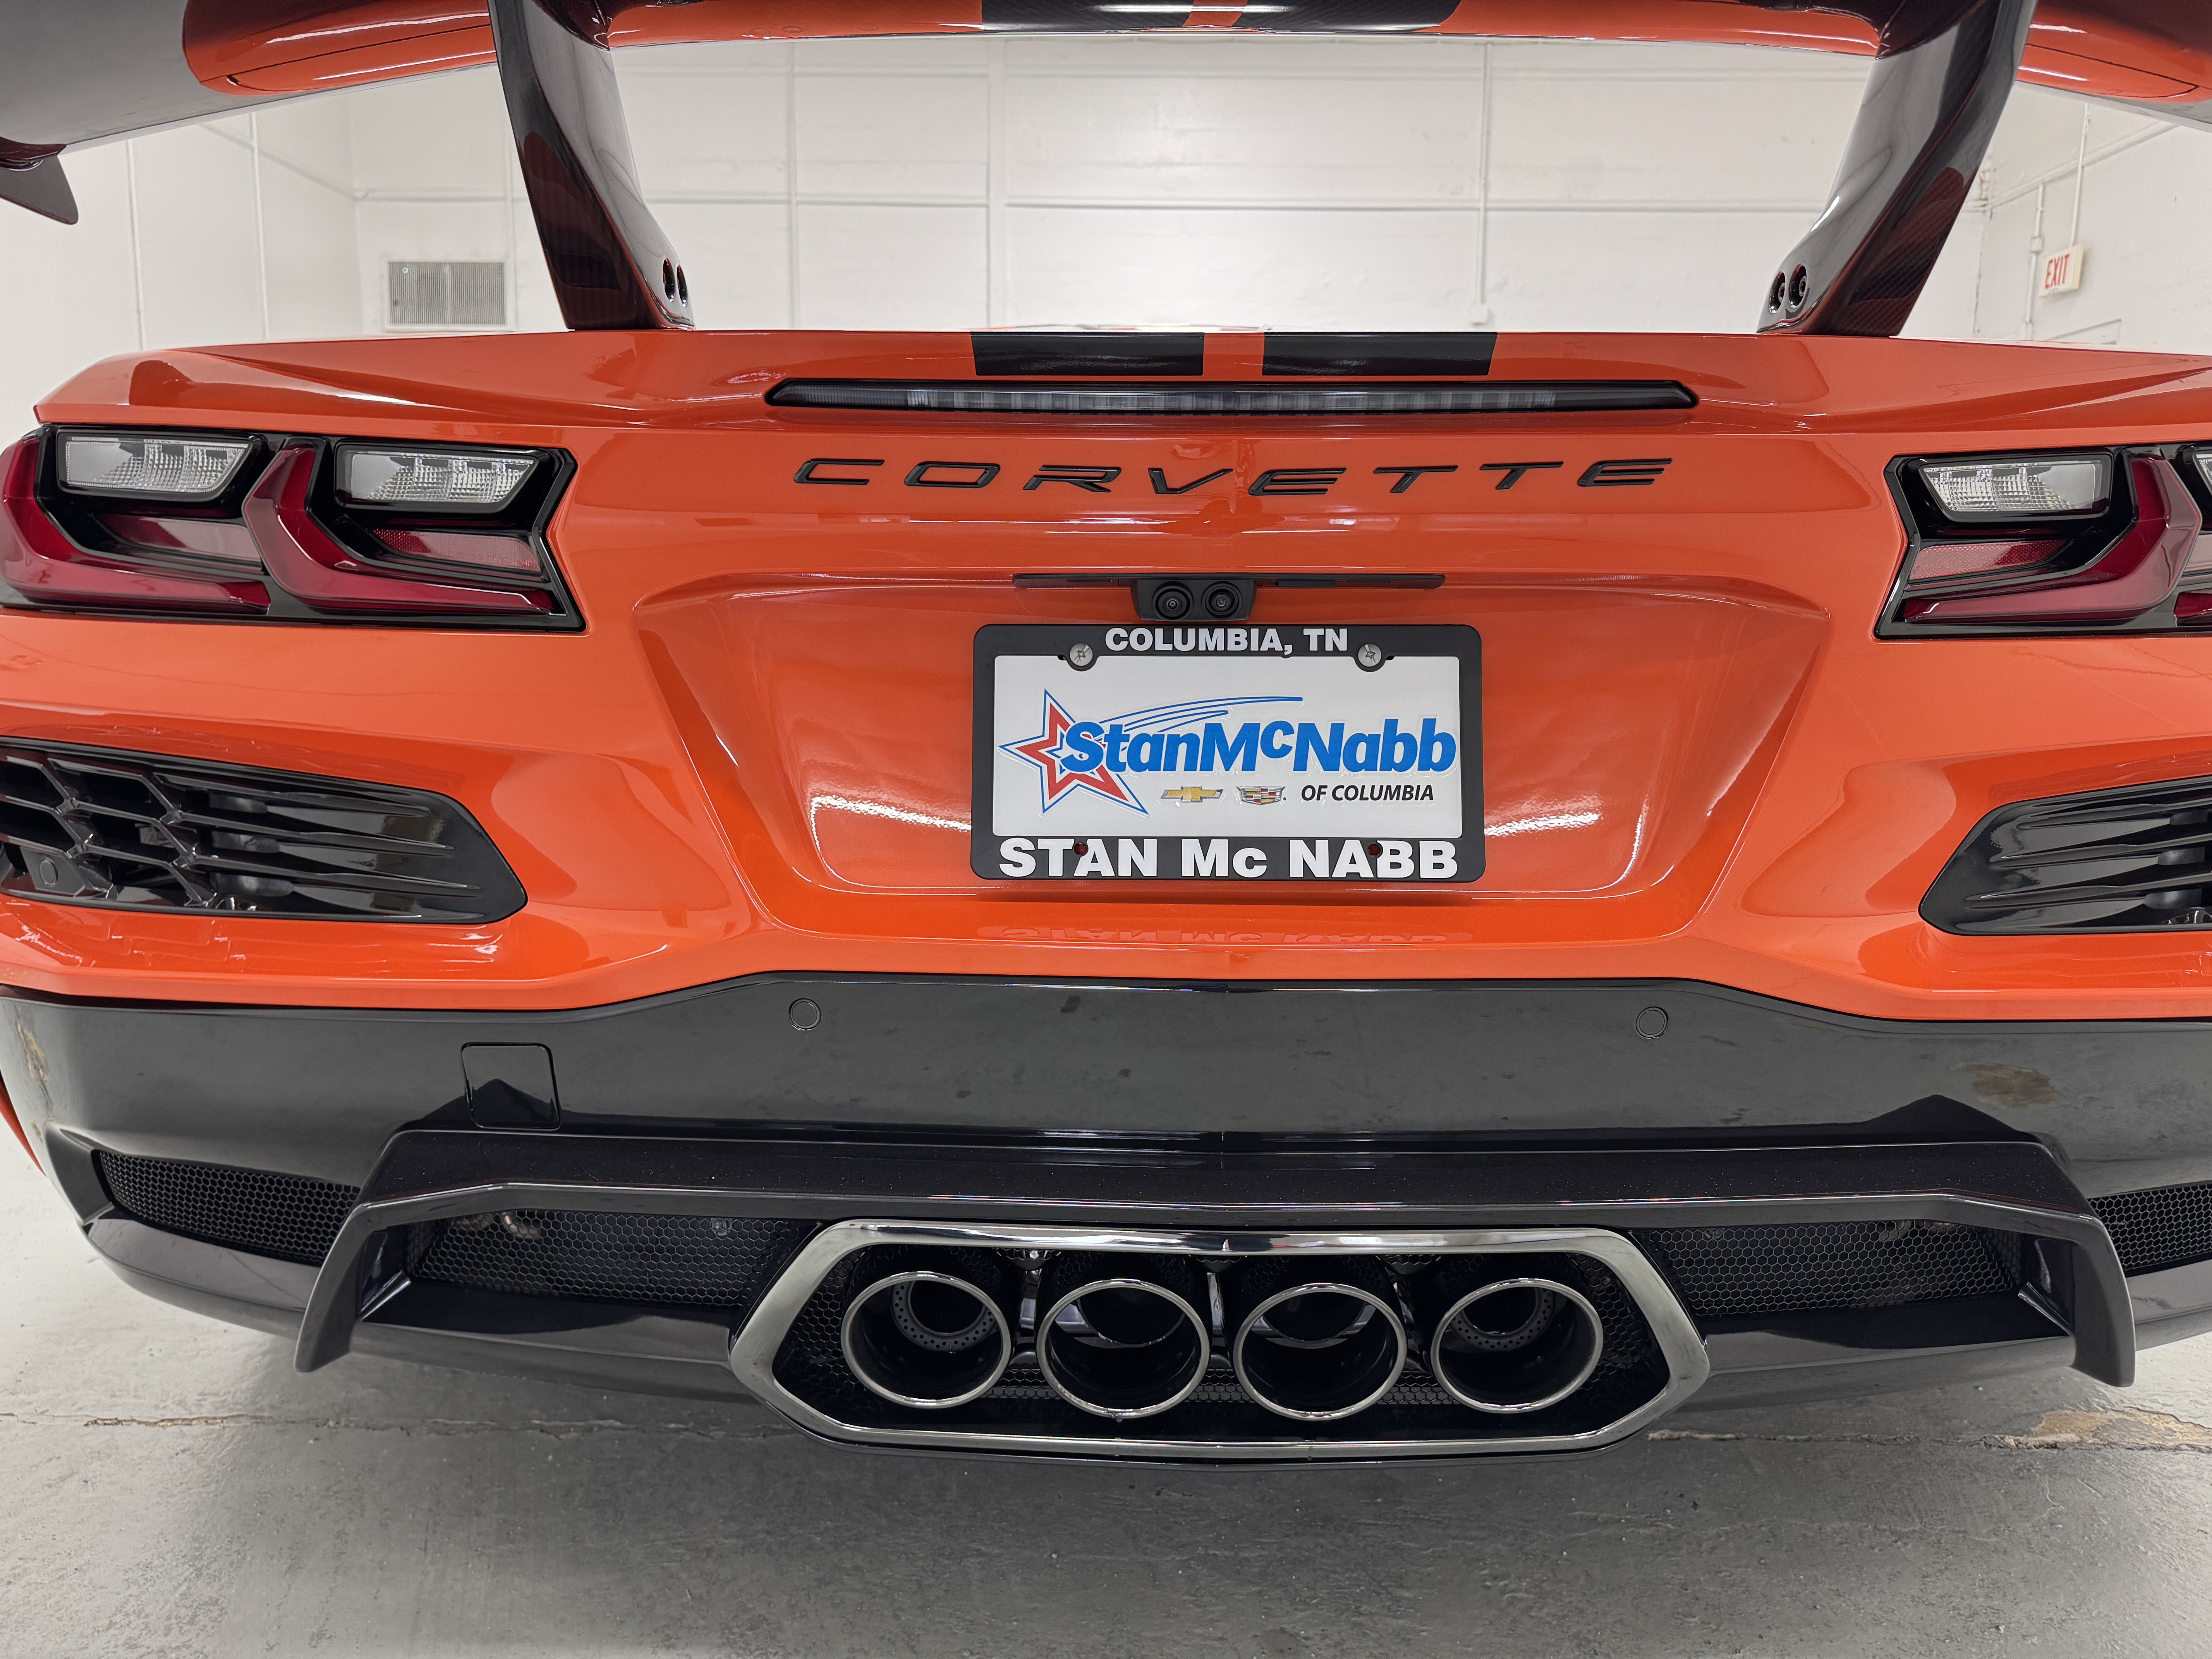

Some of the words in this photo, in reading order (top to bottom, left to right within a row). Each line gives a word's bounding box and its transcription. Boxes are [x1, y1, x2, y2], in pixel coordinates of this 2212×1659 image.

[2045, 254, 2070, 289] EXIT
[793, 458, 1673, 496] CORVETTE
[1104, 627, 1293, 655] COLUMBIA,
[1304, 628, 1348, 651] TN
[1060, 718, 1456, 774] StanMcNabb
[1301, 785, 1328, 801] OF
[1331, 785, 1434, 801] COLUMBIA
[999, 838, 1157, 878] STAN
[1181, 838, 1267, 878] Mc
[1289, 839, 1458, 879] NABB
